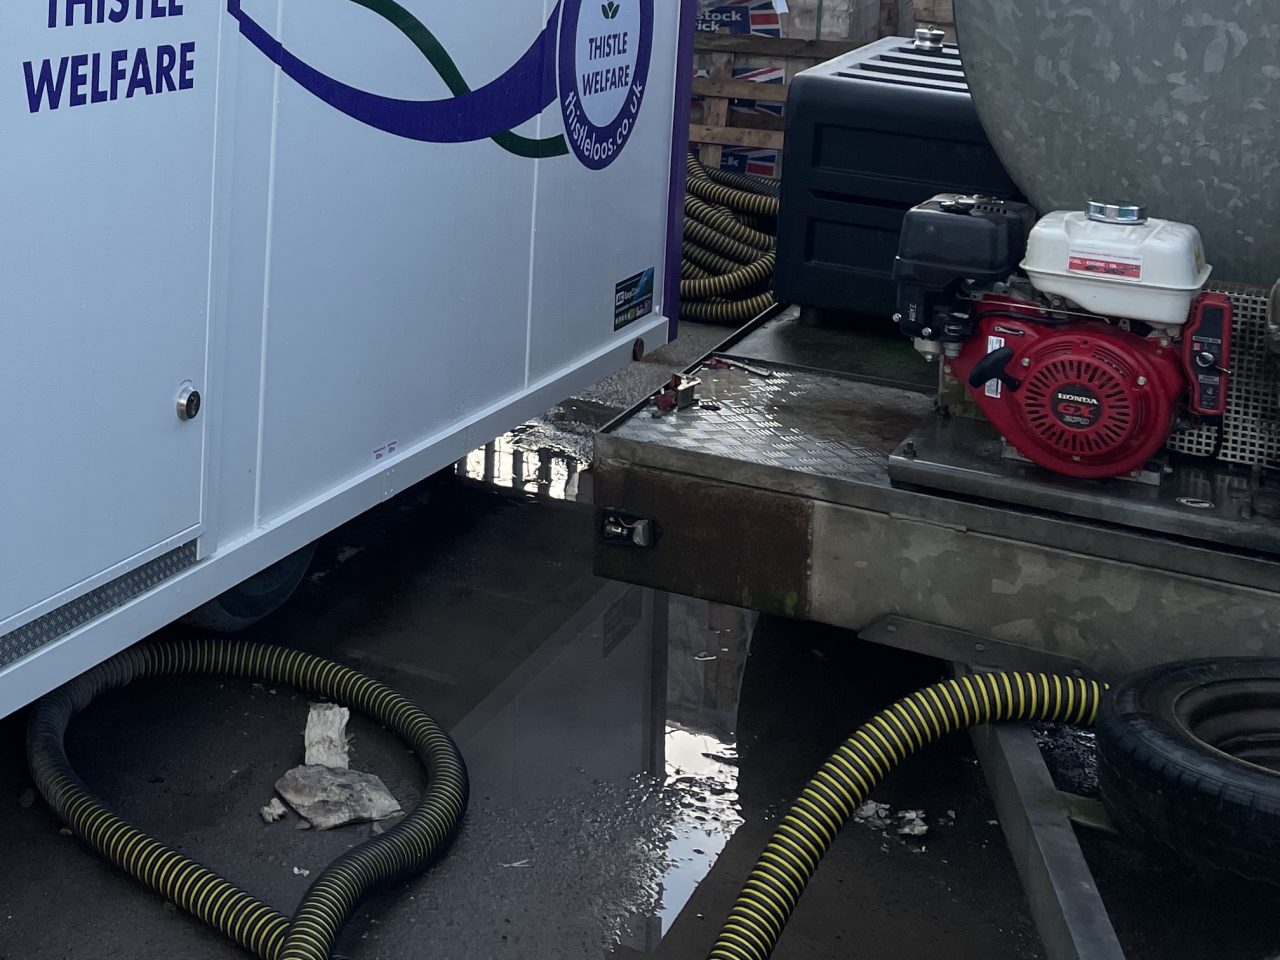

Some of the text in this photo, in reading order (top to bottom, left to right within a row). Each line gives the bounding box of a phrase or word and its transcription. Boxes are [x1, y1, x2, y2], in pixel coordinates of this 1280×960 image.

[588, 32, 628, 61] THISTLE
[22, 41, 196, 113] WELFARE
[582, 64, 631, 97] WELFARE
[1057, 392, 1099, 405] HONDA
[1058, 402, 1096, 418] GX
